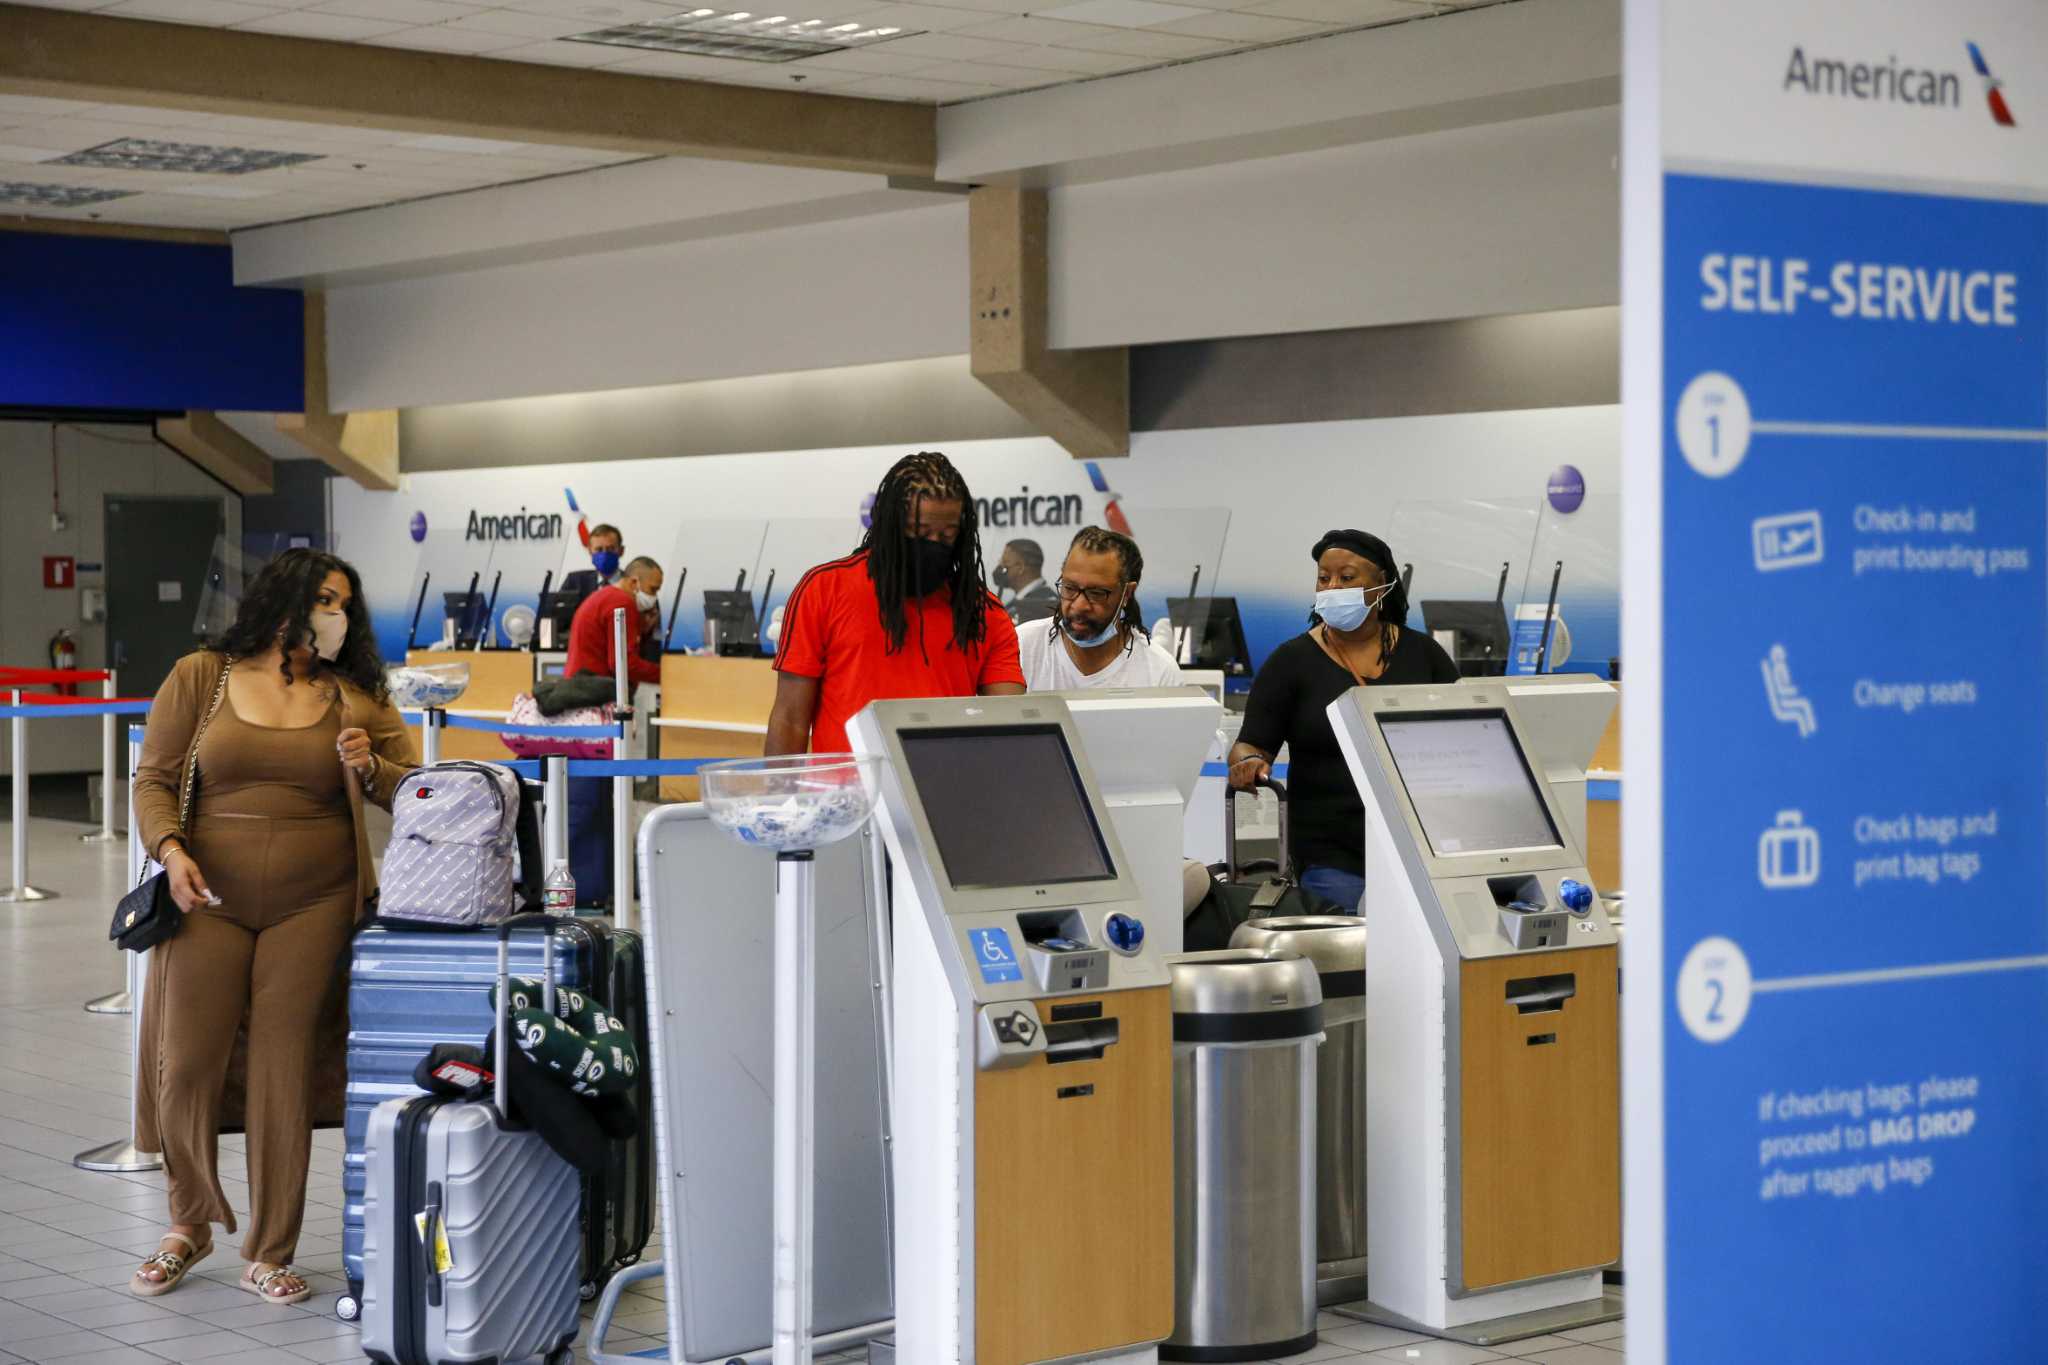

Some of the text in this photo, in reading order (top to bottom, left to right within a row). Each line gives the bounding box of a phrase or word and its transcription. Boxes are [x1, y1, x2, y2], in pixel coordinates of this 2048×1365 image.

[1784, 46, 1961, 109] American
[1700, 253, 2017, 326] SELF-SERVICE
[1704, 414, 1720, 459] 1
[466, 506, 562, 541] American
[1853, 506, 1976, 532] Check-in and
[1854, 543, 2030, 577] print boarding pass
[1854, 679, 1977, 713] Change seats
[1854, 810, 1998, 844] Check bags and
[1855, 851, 1981, 888] print bag tags
[1705, 979, 1725, 1022] 2
[1778, 1088, 1864, 1119] checking
[1918, 1075, 1980, 1108] please
[1760, 1107, 1977, 1167] proceed to BAG DROP
[1760, 1155, 1933, 1200] after tagging bags
